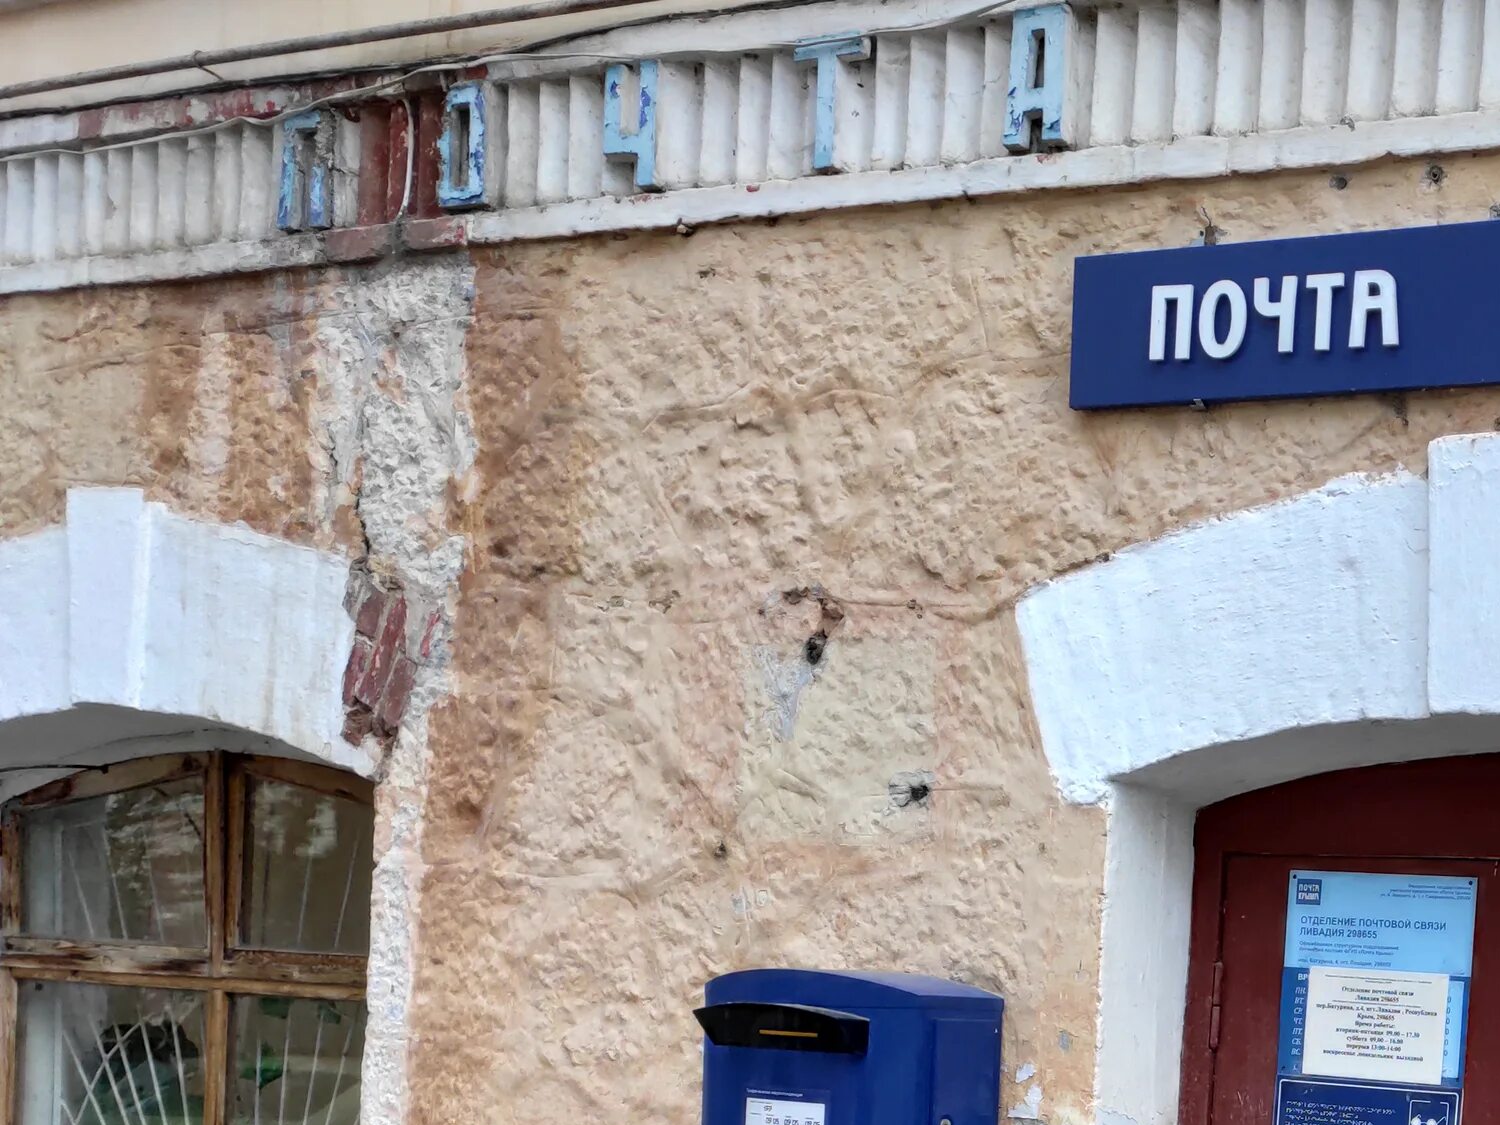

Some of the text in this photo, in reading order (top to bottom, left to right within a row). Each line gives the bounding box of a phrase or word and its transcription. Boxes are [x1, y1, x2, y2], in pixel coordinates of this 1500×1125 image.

[1148, 268, 1399, 363] ПОЧТА
[1298, 883, 1320, 892] ПОЧТА
[1300, 916, 1446, 931] ОТДЕЛЕНИЕ ПОЧТОВОЙ СВЯЗИ
[1300, 927, 1378, 939] ЛИВАДИЯ 298655
